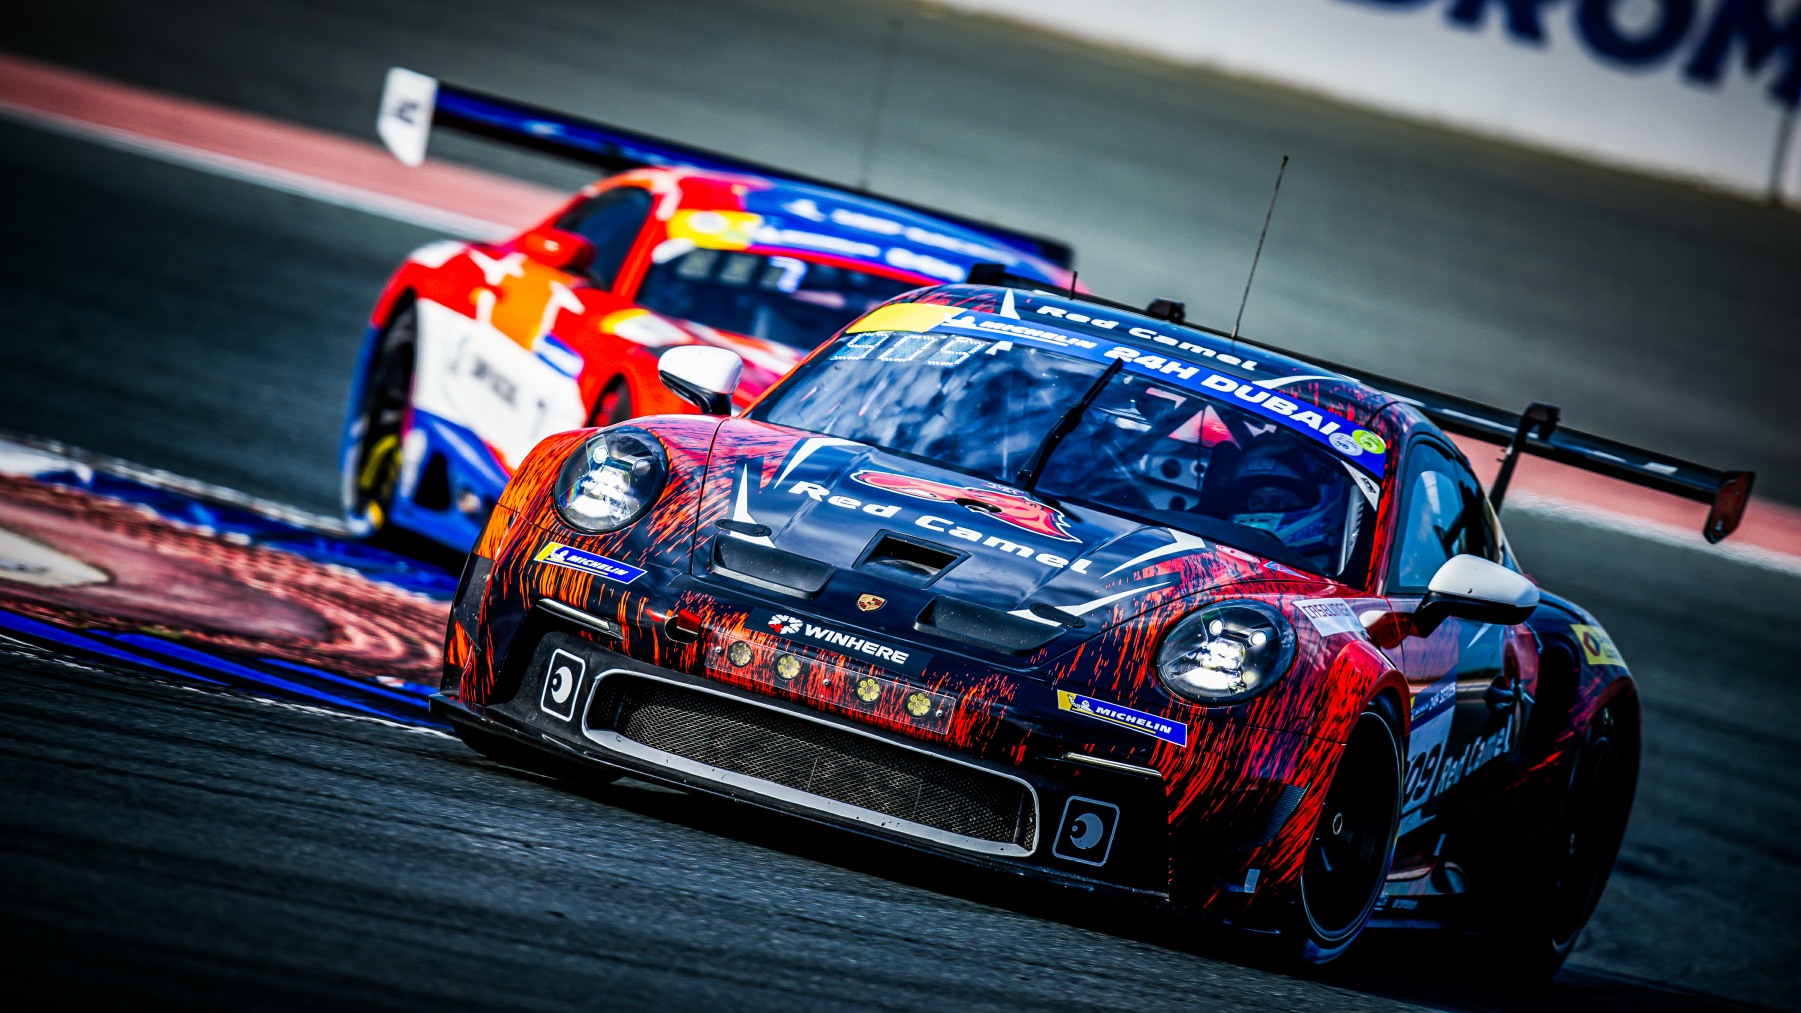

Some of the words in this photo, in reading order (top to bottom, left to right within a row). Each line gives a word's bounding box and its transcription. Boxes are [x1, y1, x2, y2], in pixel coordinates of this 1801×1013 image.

[829, 331, 987, 367] 909
[979, 320, 1098, 349] MICHELIN
[1037, 305, 1120, 330] Red
[1128, 326, 1258, 372] Camel
[1104, 346, 1200, 380] 24H
[1200, 374, 1341, 435] DUBAI
[788, 480, 902, 518] Red
[914, 515, 1093, 575] Camel
[566, 554, 629, 576] MICHELIN
[804, 623, 910, 665] WINHERE
[1095, 706, 1172, 734] MICHELIN
[1403, 743, 1438, 802] 09
[1429, 743, 1471, 797] Red
[1465, 714, 1513, 777] Camel
